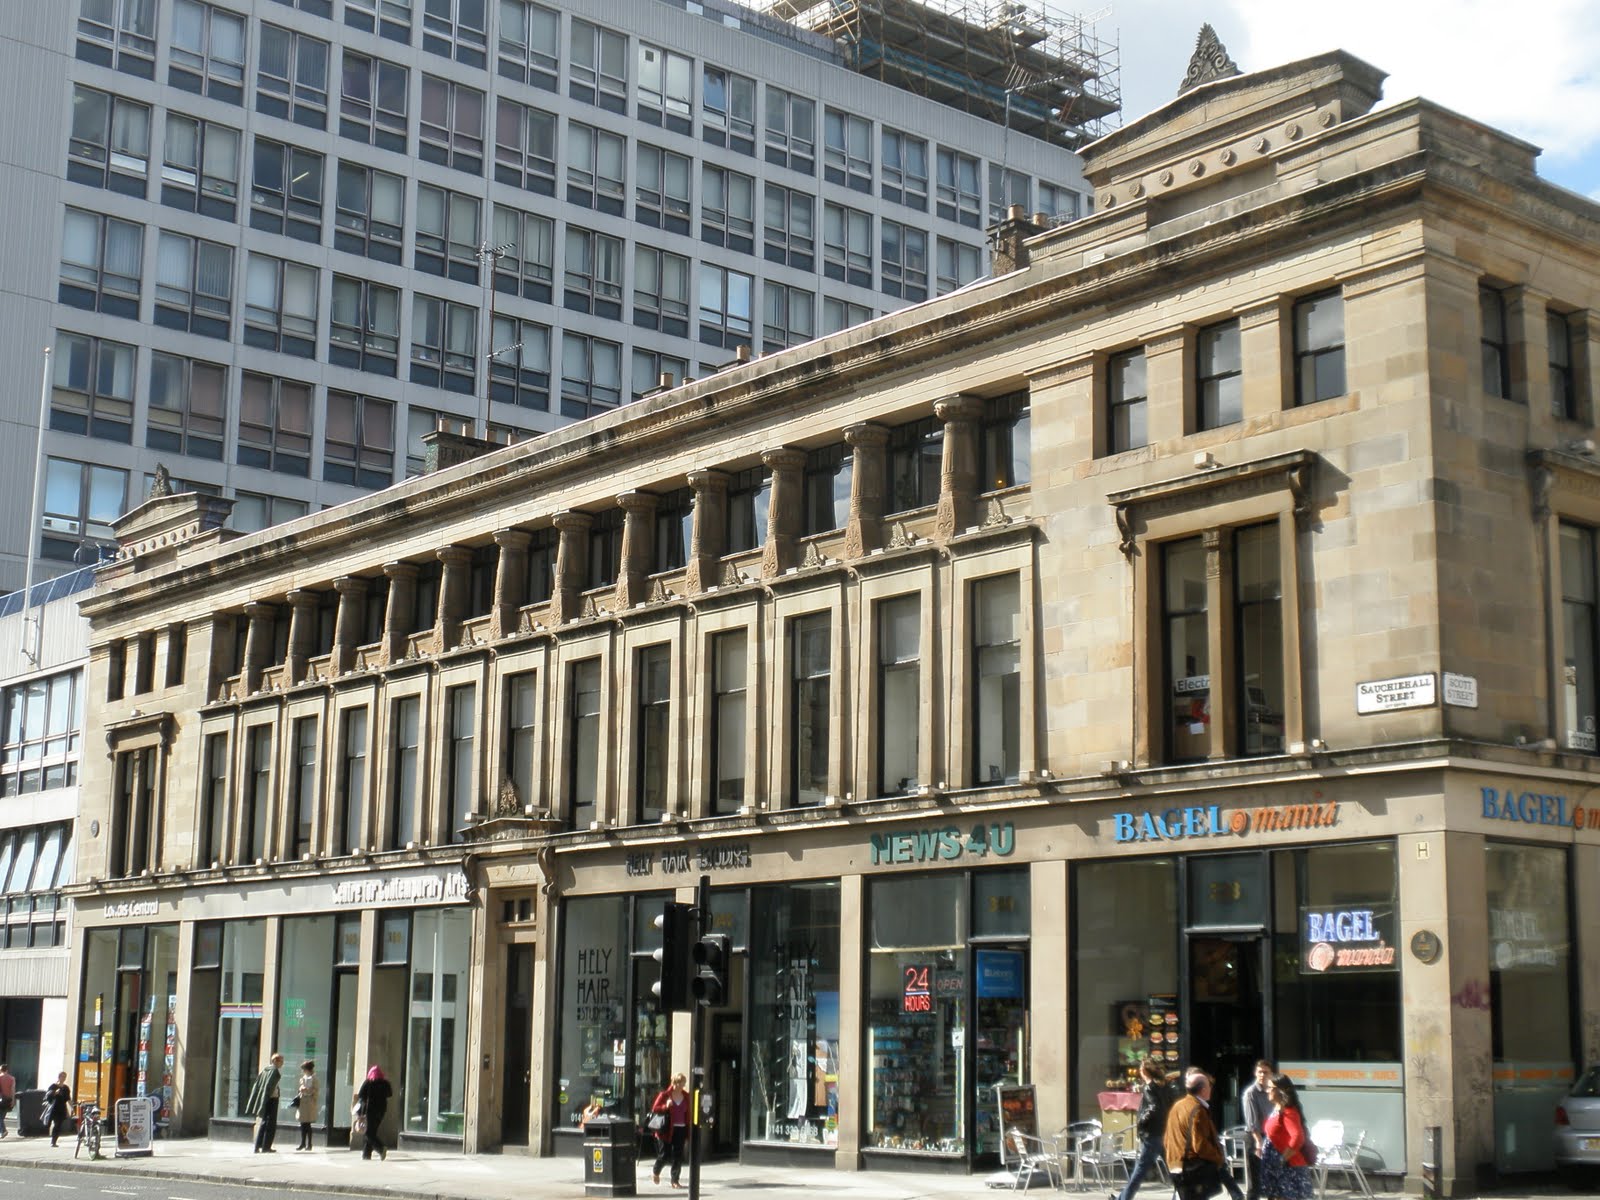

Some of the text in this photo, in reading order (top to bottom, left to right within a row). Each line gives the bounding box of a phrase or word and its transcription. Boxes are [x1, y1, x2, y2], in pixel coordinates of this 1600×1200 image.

[1360, 679, 1431, 695] SAUCHIEHALL
[1449, 678, 1473, 690] SCOTT
[1376, 691, 1416, 703] STREET
[1447, 688, 1474, 702] STREET
[1481, 787, 1574, 827] BAGEL
[1113, 806, 1230, 842] BAGEL
[130, 898, 159, 916] Central
[1308, 911, 1380, 942] BAGEL
[577, 948, 612, 975] HELY
[905, 967, 928, 991] 24
[936, 978, 963, 991] OPEN
[577, 978, 610, 1004] HAIR
[904, 995, 930, 1011] HOURS
